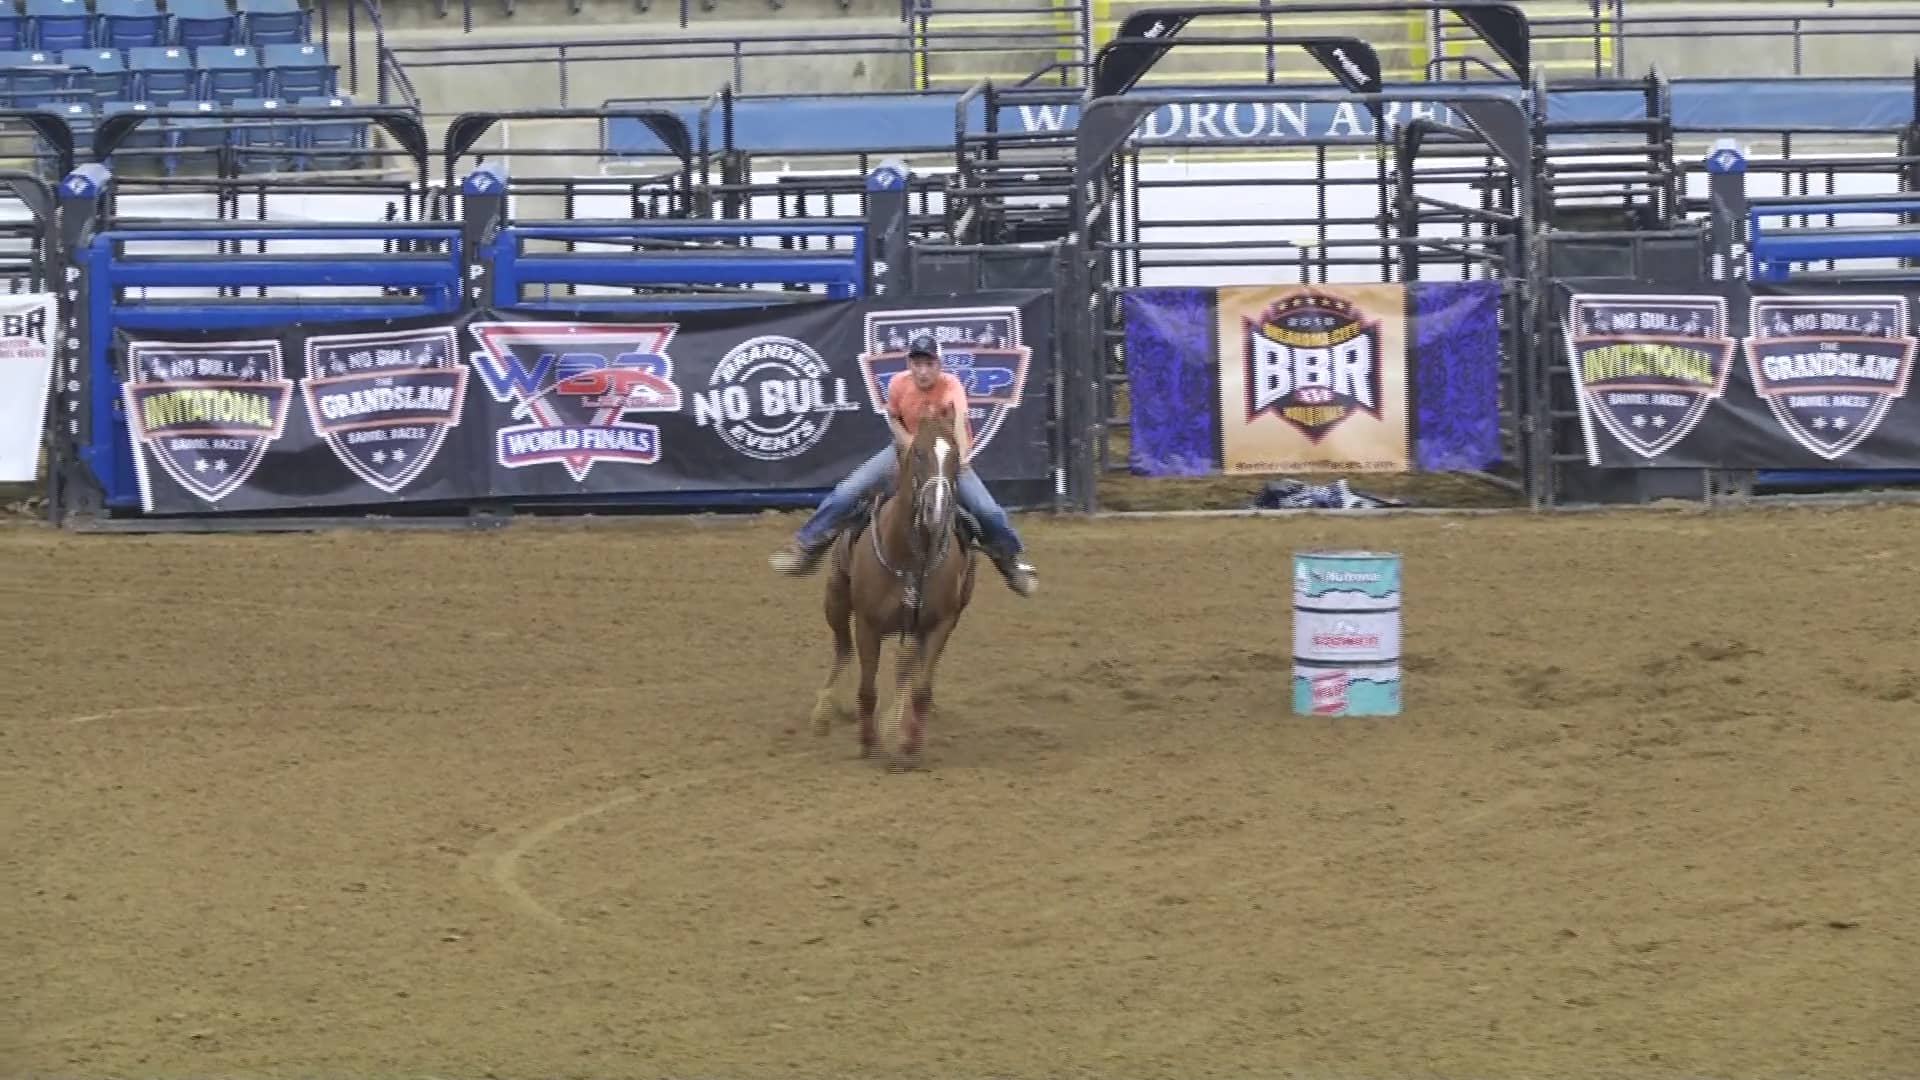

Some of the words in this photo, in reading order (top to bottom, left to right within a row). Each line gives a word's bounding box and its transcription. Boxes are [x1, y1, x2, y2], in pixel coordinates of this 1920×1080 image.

[2, 306, 46, 345] BR
[1613, 312, 1638, 330] NO
[1641, 311, 1680, 330] BULL
[1793, 313, 1818, 331] NO
[1821, 312, 1863, 330] BULL
[171, 359, 194, 377] NO
[198, 358, 238, 377] BULL
[348, 351, 373, 369] NO
[376, 349, 416, 366] BULL
[720, 344, 822, 383] BRANDED
[1252, 332, 1375, 411] BBR
[1582, 344, 1714, 385] INVITATIONAL
[1761, 352, 1901, 382] GRANDSLAM
[143, 389, 274, 431] INVITATIONAL
[319, 385, 455, 419] GRANDSLAM
[692, 385, 751, 427] NO
[759, 377, 861, 417] BULL
[507, 429, 580, 456] WORLD
[582, 428, 651, 453] FINALS
[728, 420, 817, 450] EVENTS
